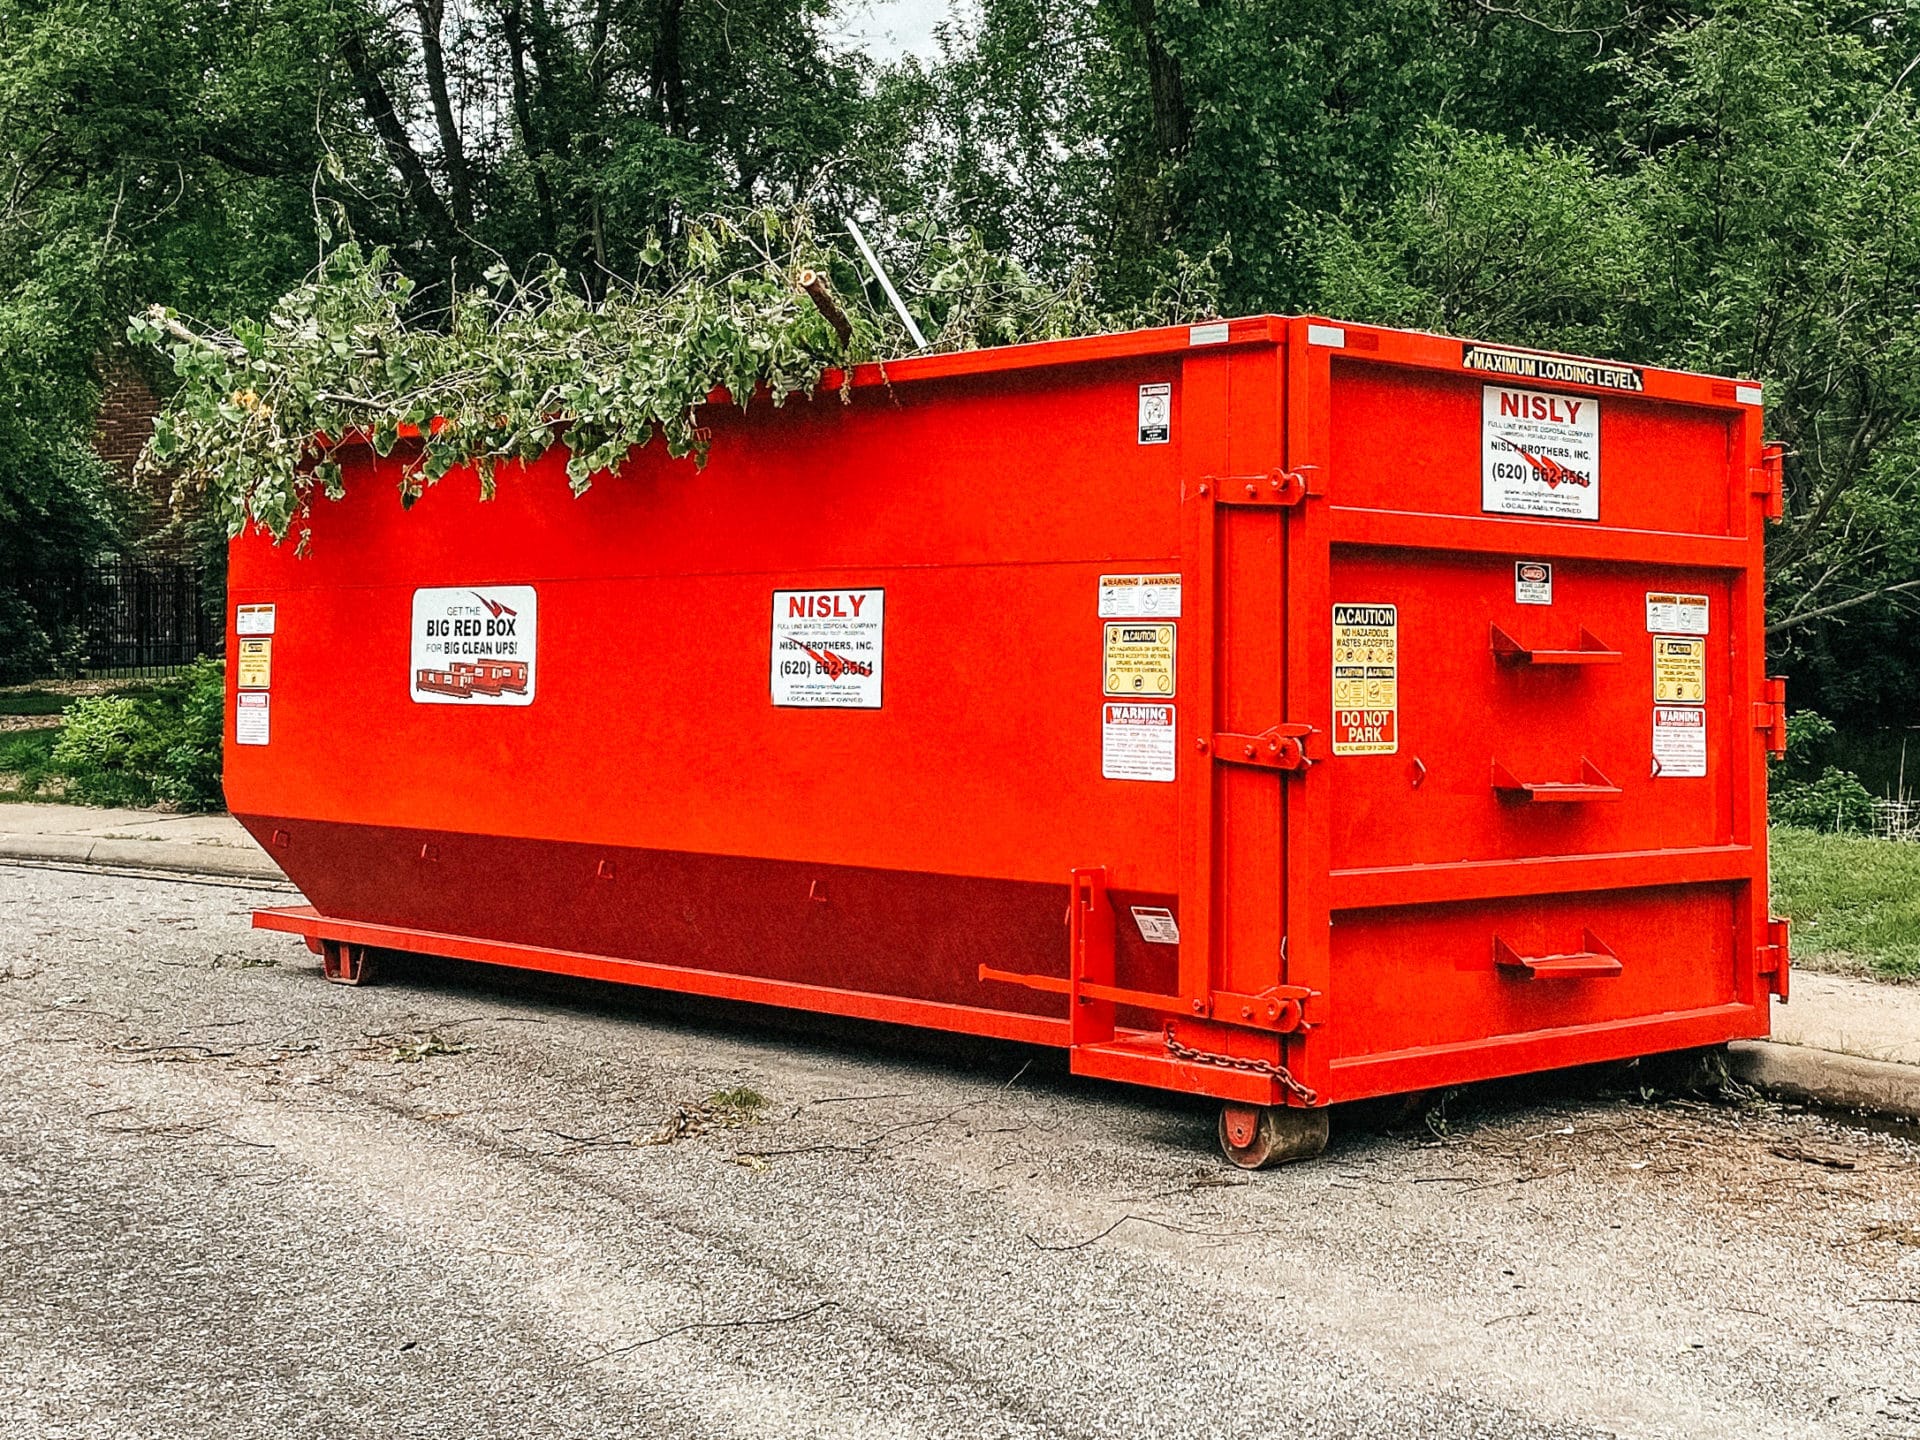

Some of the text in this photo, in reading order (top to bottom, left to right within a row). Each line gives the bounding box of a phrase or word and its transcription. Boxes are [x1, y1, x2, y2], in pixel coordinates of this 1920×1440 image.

[1473, 351, 1635, 390] MAXIMUM LOADING LEVEL
[1500, 392, 1582, 424] NISLY
[1518, 424, 1539, 432] WASTE
[1540, 427, 1566, 435] DISPOSAL
[1568, 430, 1594, 438] COMPANY
[1491, 442, 1591, 460] NISLY BROTHERS, INC.
[1492, 462, 1527, 484] (620)
[1528, 504, 1553, 512] FAMILY
[1108, 578, 1138, 586] WARNING
[446, 606, 480, 616] GET THE
[789, 594, 866, 618] NISLY
[1346, 608, 1393, 624] CAUTION
[426, 618, 516, 636] BIG RED BOX
[1342, 628, 1389, 637] NO HAZARDOUS
[1130, 632, 1156, 641] CAUTION
[1336, 638, 1394, 648] WASTES ACCEPTED
[426, 642, 518, 655] FOR BIG CLEAN UPS!
[780, 642, 874, 651] NISLY BROTHERS, INC.
[780, 660, 810, 678] (620)
[1112, 706, 1168, 720] WARNING
[1342, 711, 1390, 726] DO NOT
[1660, 710, 1700, 722] WARNING
[1348, 727, 1382, 742] PARK
